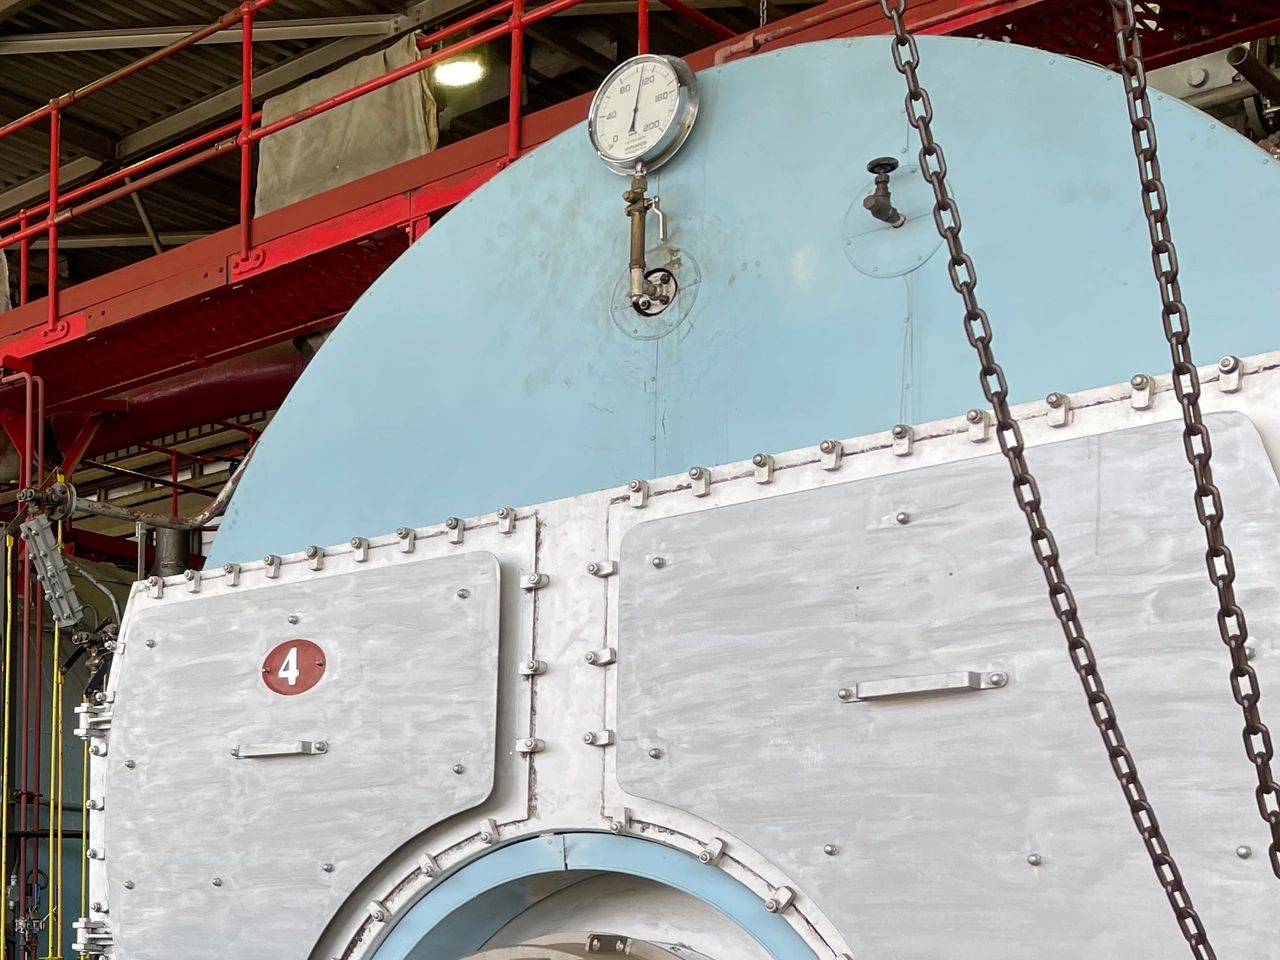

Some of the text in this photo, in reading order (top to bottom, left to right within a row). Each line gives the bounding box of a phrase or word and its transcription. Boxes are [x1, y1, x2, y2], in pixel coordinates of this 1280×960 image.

[641, 74, 655, 86] 120
[619, 84, 631, 95] 80
[654, 91, 669, 103] 160
[606, 110, 617, 120] 40
[642, 119, 660, 133] 200
[612, 134, 619, 143] 0
[278, 646, 300, 686] 4
